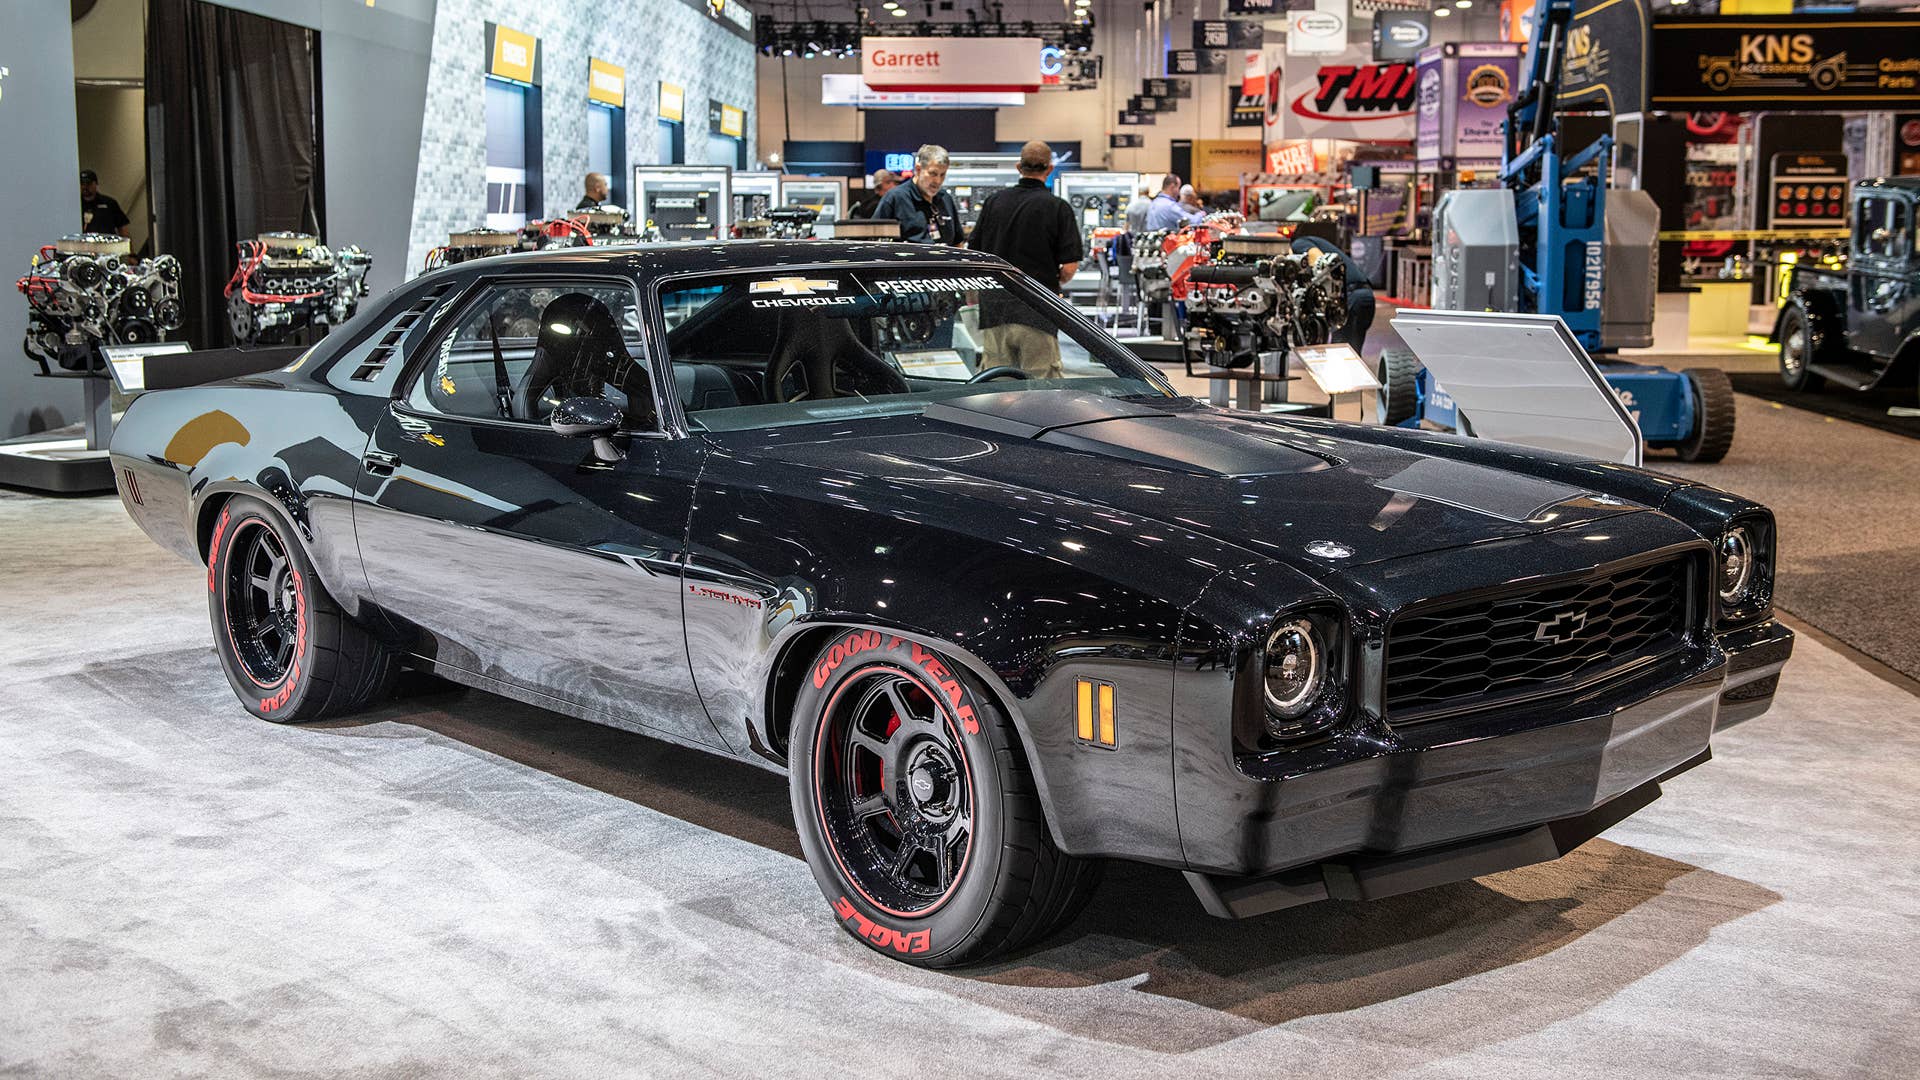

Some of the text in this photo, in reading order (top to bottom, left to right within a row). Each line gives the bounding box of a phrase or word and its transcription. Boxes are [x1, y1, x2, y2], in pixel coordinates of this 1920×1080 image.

[1740, 34, 1815, 63] KNS
[872, 50, 939, 67] Garrett
[1738, 63, 1812, 74] ACCESSORIES
[1314, 64, 1417, 112] TMI
[1879, 74, 1915, 88] Parts
[1585, 241, 1602, 309] 10217956
[875, 276, 1004, 295] PERFORMANCE
[751, 296, 856, 308] CHEVROLET
[832, 895, 932, 954] EAGLE
